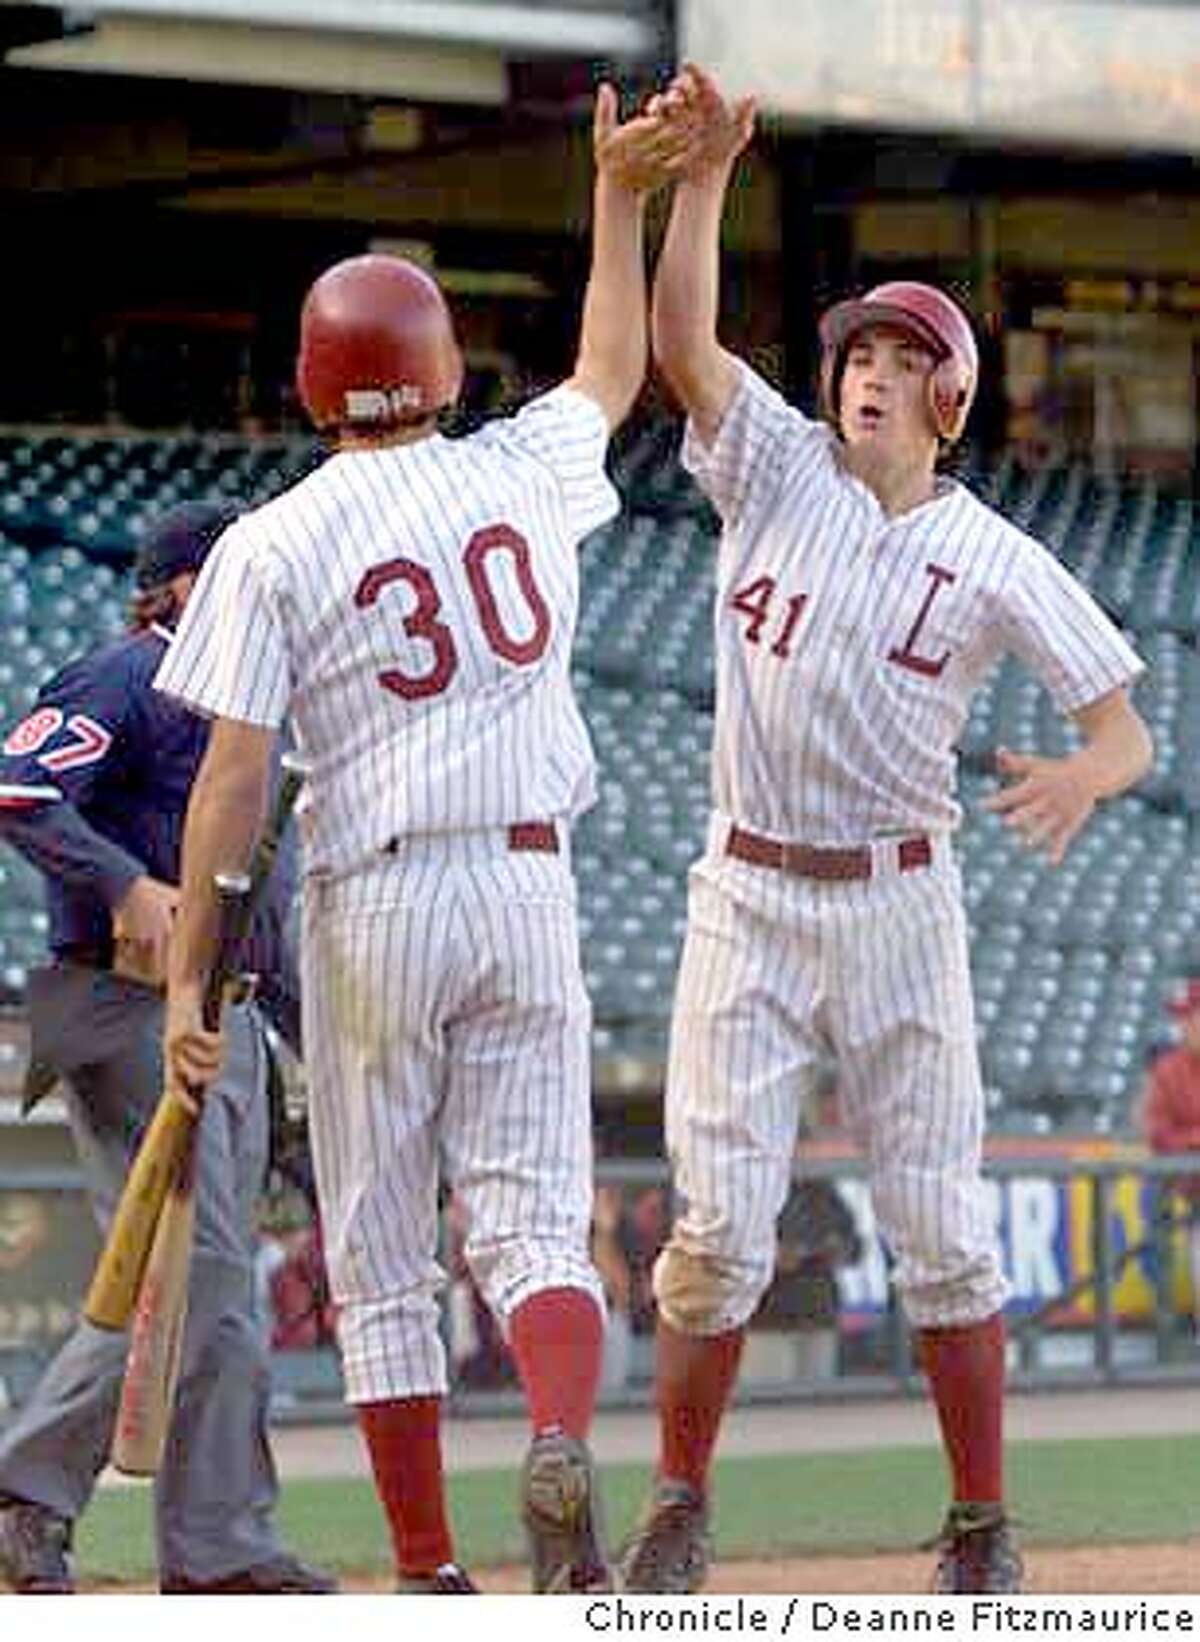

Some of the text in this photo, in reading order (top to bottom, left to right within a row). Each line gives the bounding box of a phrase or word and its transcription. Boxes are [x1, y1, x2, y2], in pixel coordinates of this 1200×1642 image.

[354, 523, 551, 700] 30
[730, 574, 808, 661] 41
[886, 562, 956, 678] L
